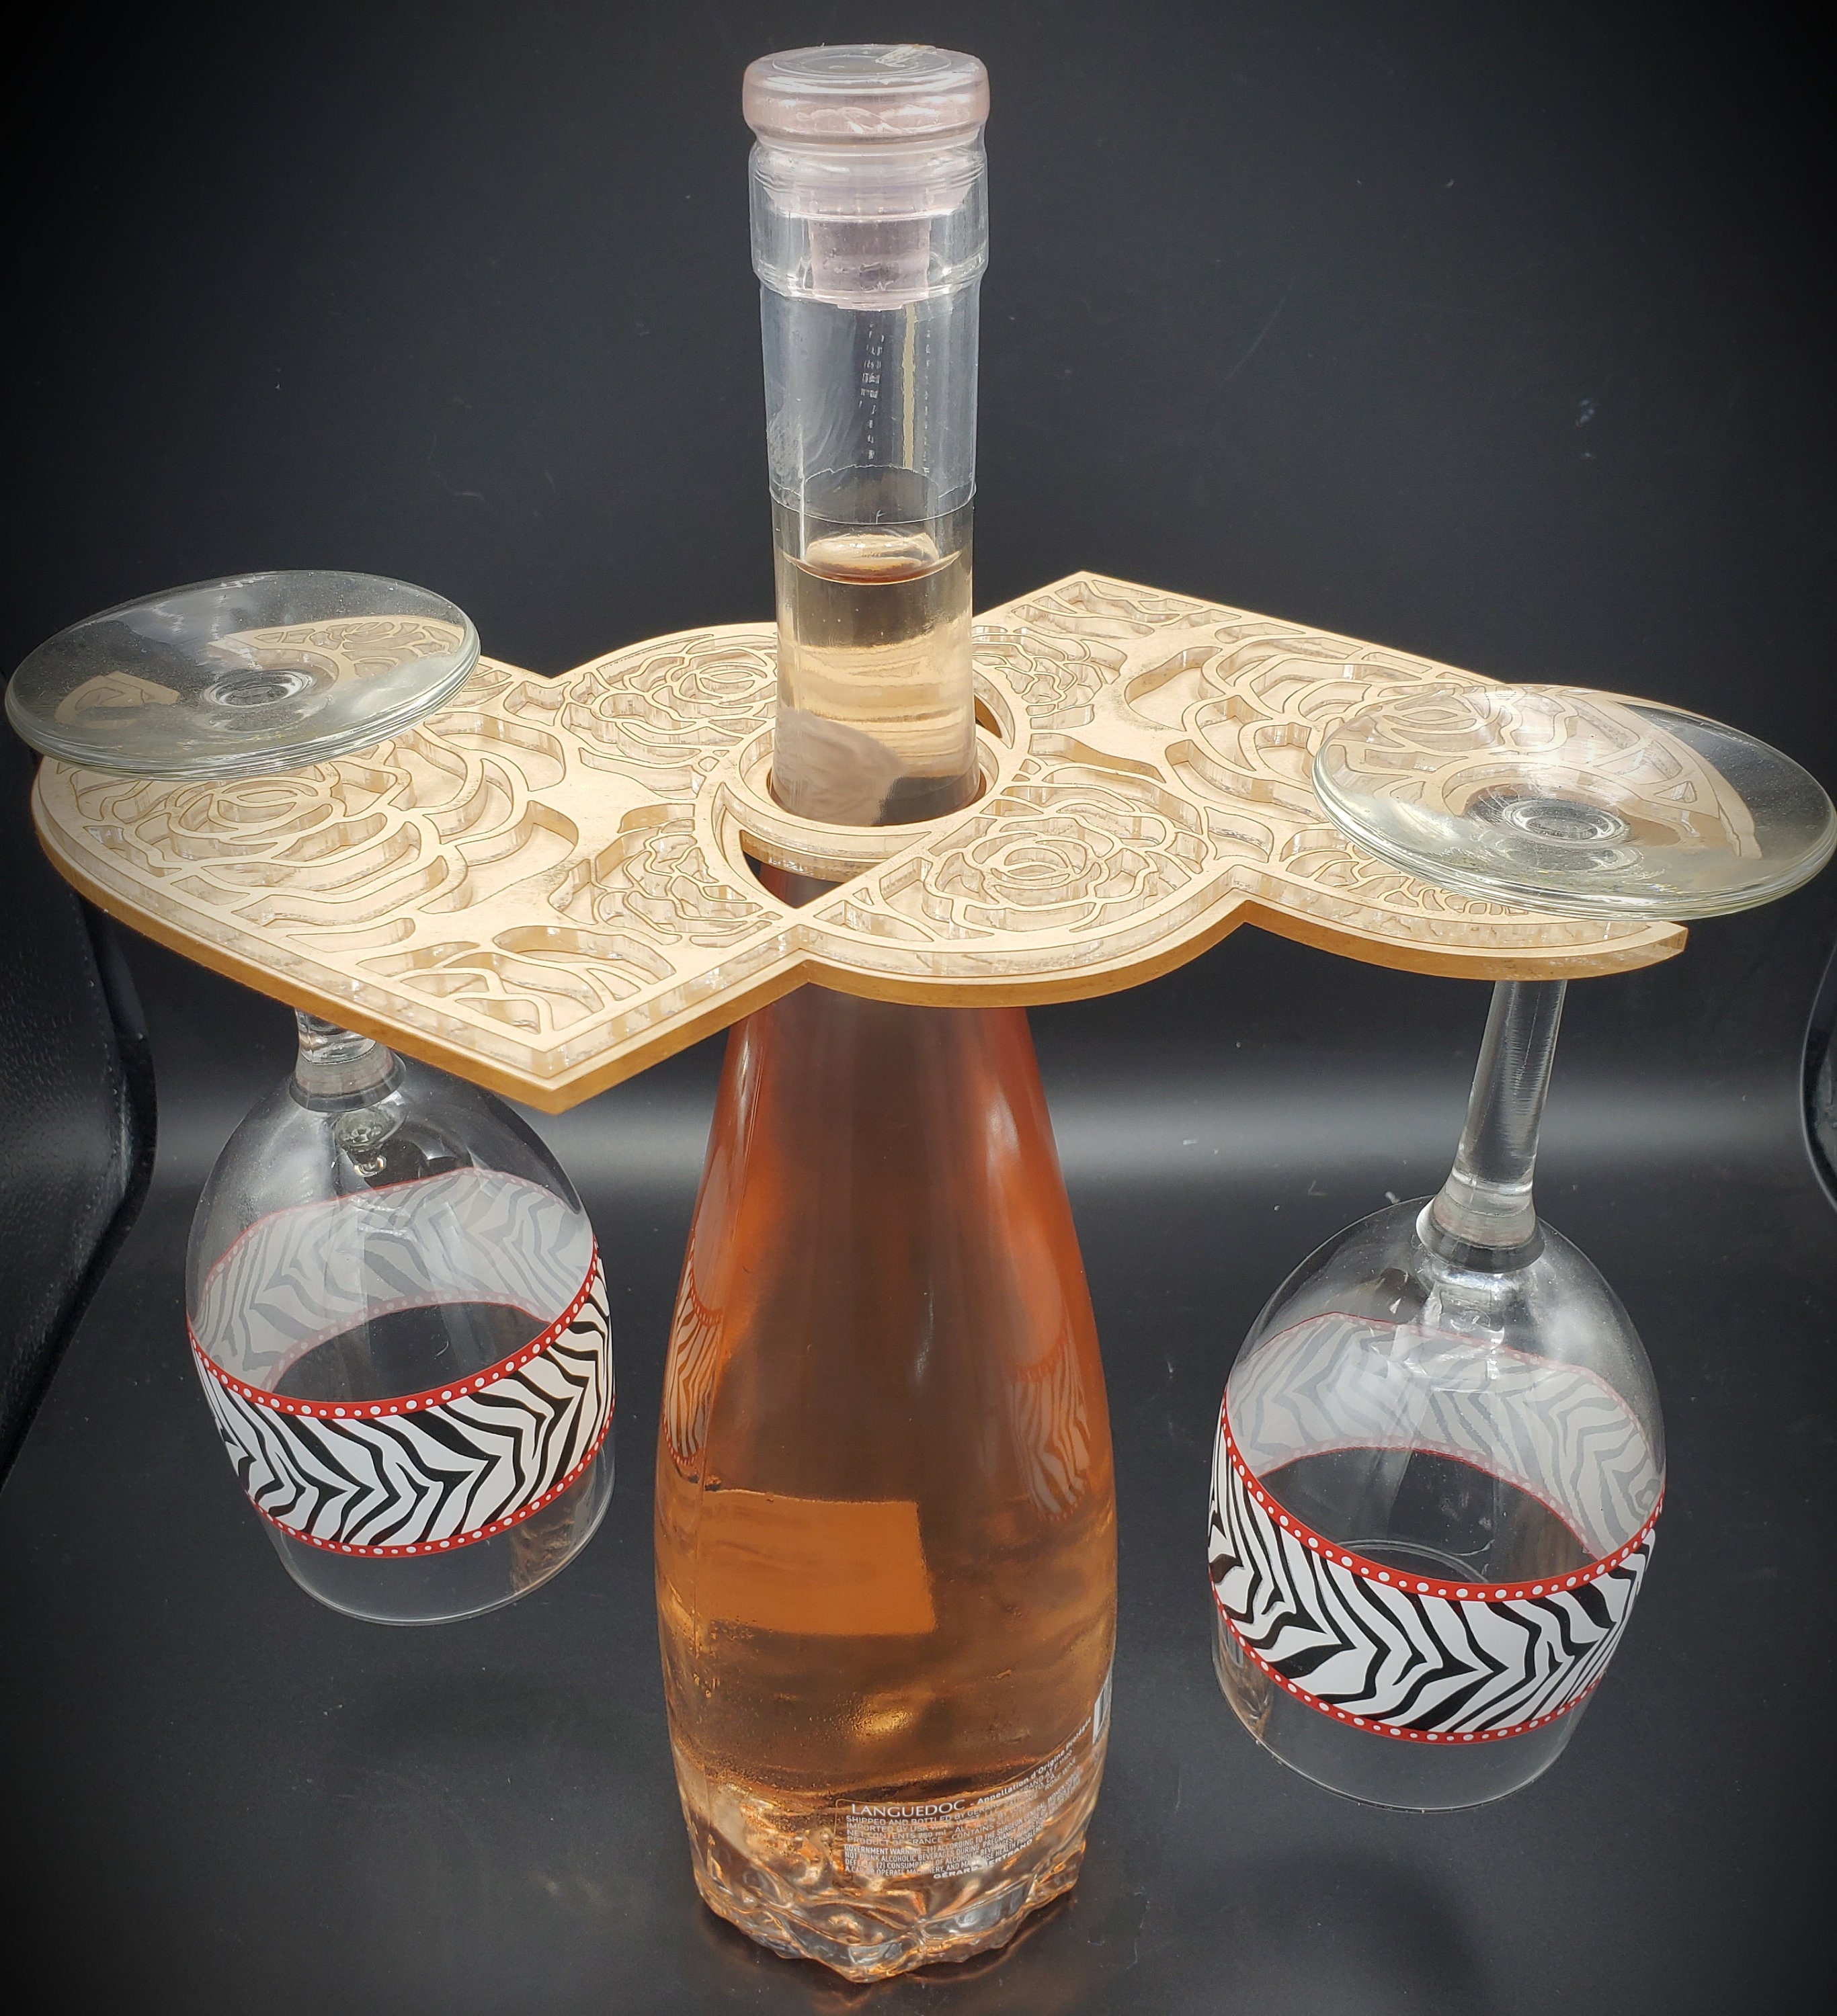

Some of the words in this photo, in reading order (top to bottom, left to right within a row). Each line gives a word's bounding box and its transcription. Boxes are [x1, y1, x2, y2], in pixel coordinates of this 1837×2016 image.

[851, 1799, 965, 1817] LANGUEDOC
[977, 1777, 1029, 1806] Appellation
[846, 1815, 886, 1826] SHIPPED
[846, 1822, 893, 1833] IMPORTED
[896, 1824, 908, 1833] BY
[847, 1829, 864, 1837] NET
[847, 1835, 889, 1845] PRODUCT
[951, 1823, 995, 1840] CONTAINS
[844, 1844, 889, 1855] GOVERNMENT
[938, 1839, 974, 1851] ACCORDING
[976, 1835, 983, 1843] TO
[985, 1830, 996, 1841] THE
[918, 1849, 954, 1861] BEVERAGES
[956, 1843, 979, 1855] DURING
[946, 1861, 959, 1872] AND
